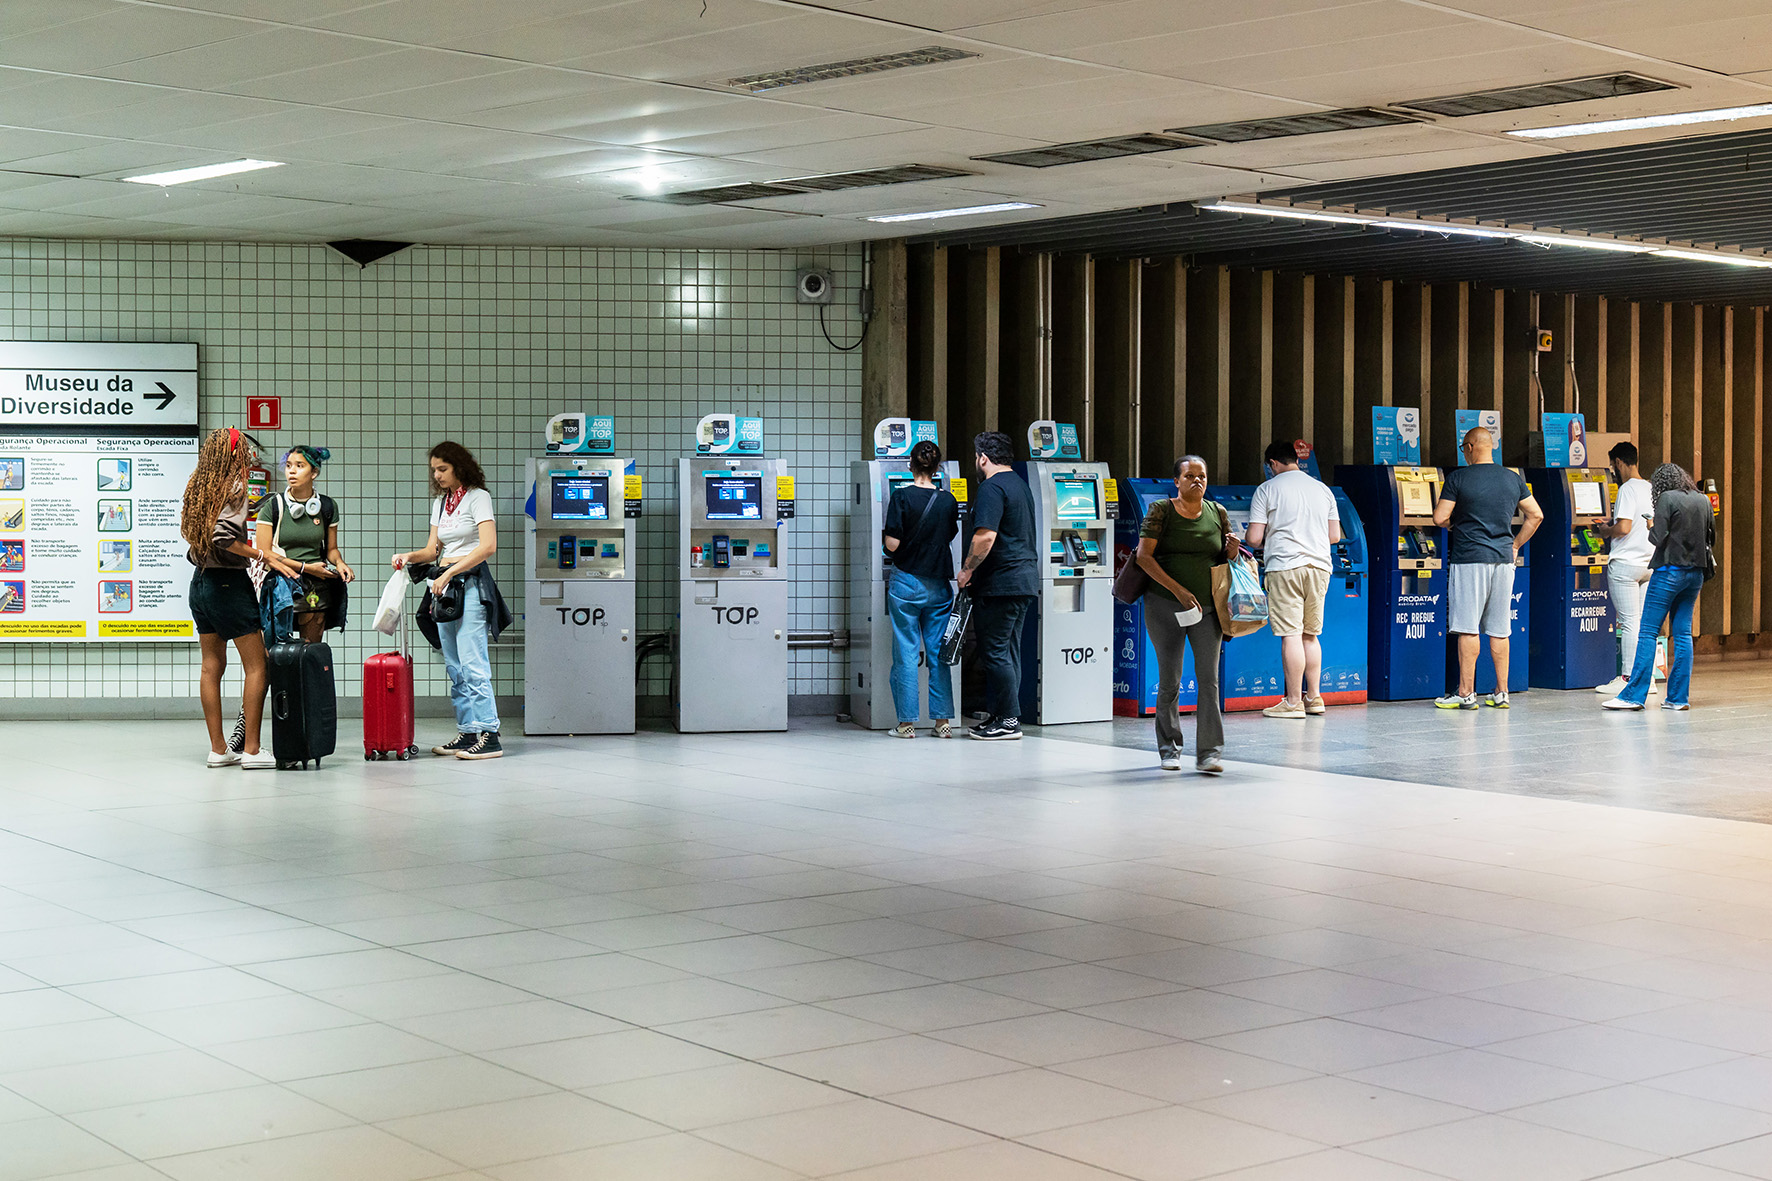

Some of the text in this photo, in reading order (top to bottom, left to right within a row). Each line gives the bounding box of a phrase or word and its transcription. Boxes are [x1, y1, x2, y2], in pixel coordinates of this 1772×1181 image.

[26, 374, 133, 392] Museu da
[1, 397, 134, 415] Diversidade
[741, 431, 760, 439] TOP
[556, 608, 605, 626] TOP
[711, 607, 759, 625] TOP
[1396, 612, 1435, 623] REC RREGUE
[1571, 606, 1606, 617] RECARREGUE
[1406, 624, 1425, 639] AQUI
[1580, 618, 1598, 632] AQUI
[1061, 648, 1093, 664] TOP
